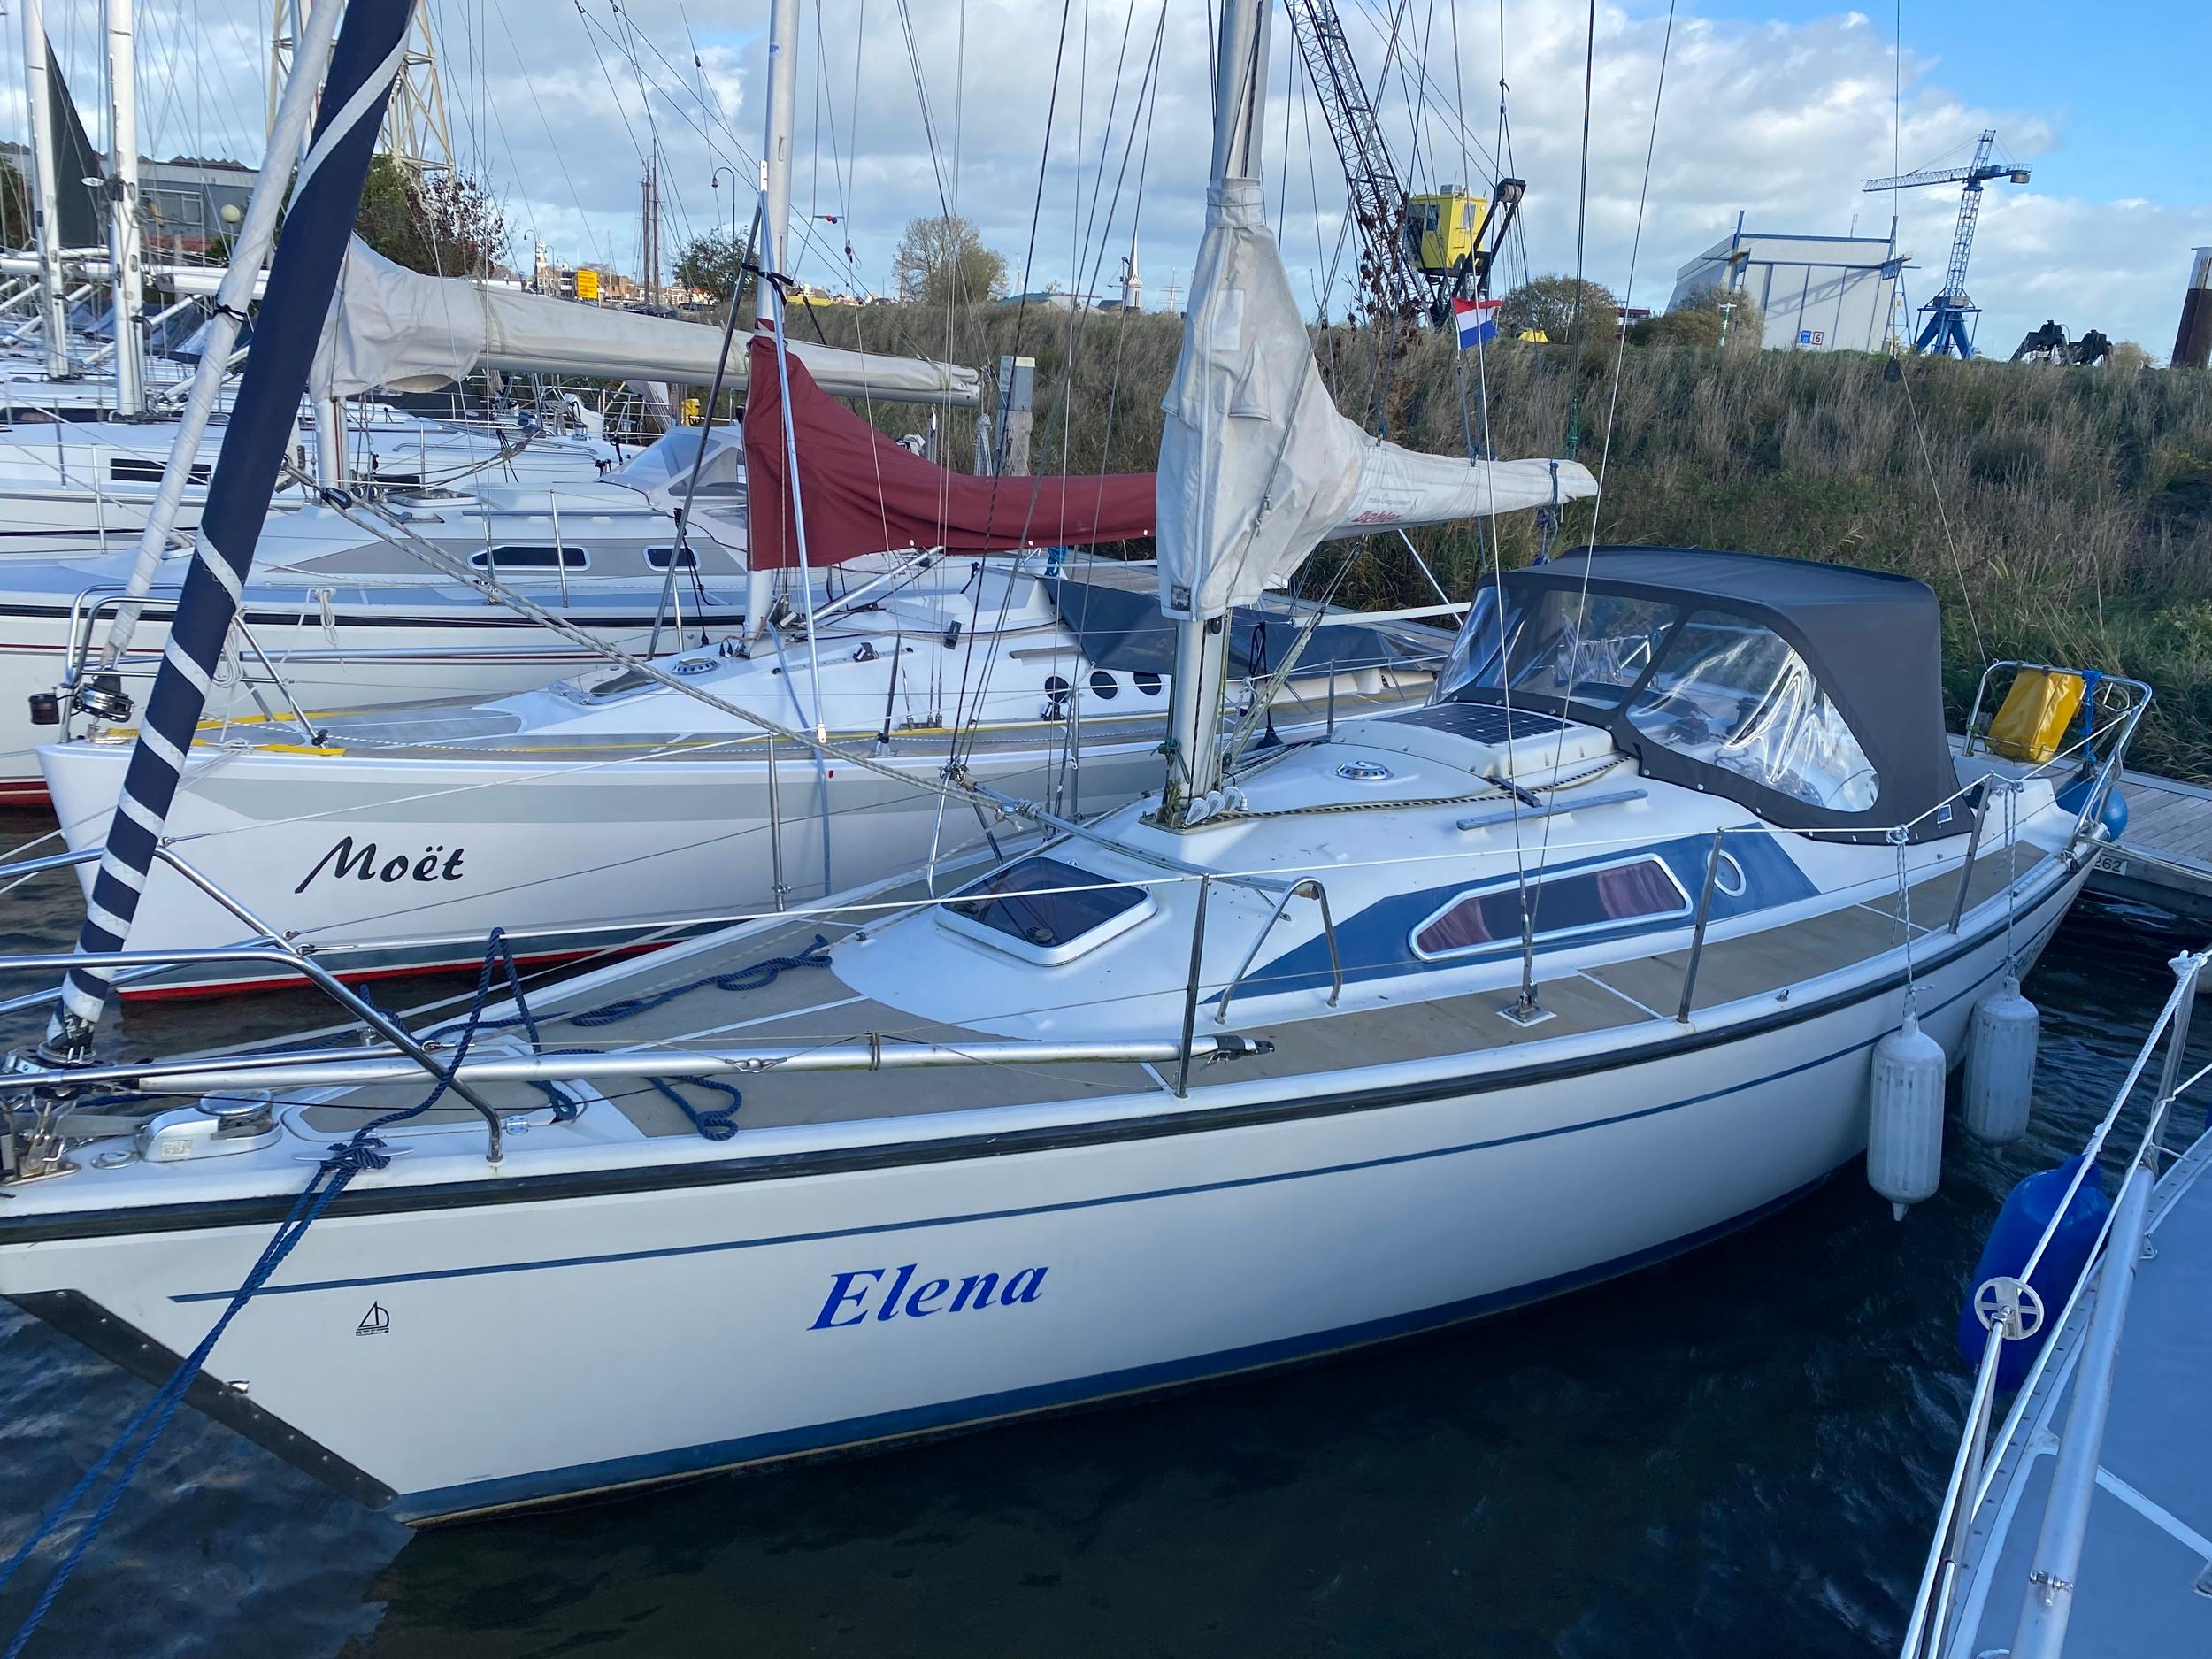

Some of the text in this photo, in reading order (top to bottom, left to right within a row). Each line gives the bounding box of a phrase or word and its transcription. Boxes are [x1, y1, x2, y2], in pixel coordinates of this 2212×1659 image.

[1815, 334, 1821, 342] 6
[295, 835, 465, 894] Moët
[2094, 856, 2122, 872] 262
[806, 1263, 1049, 1331] Elena
